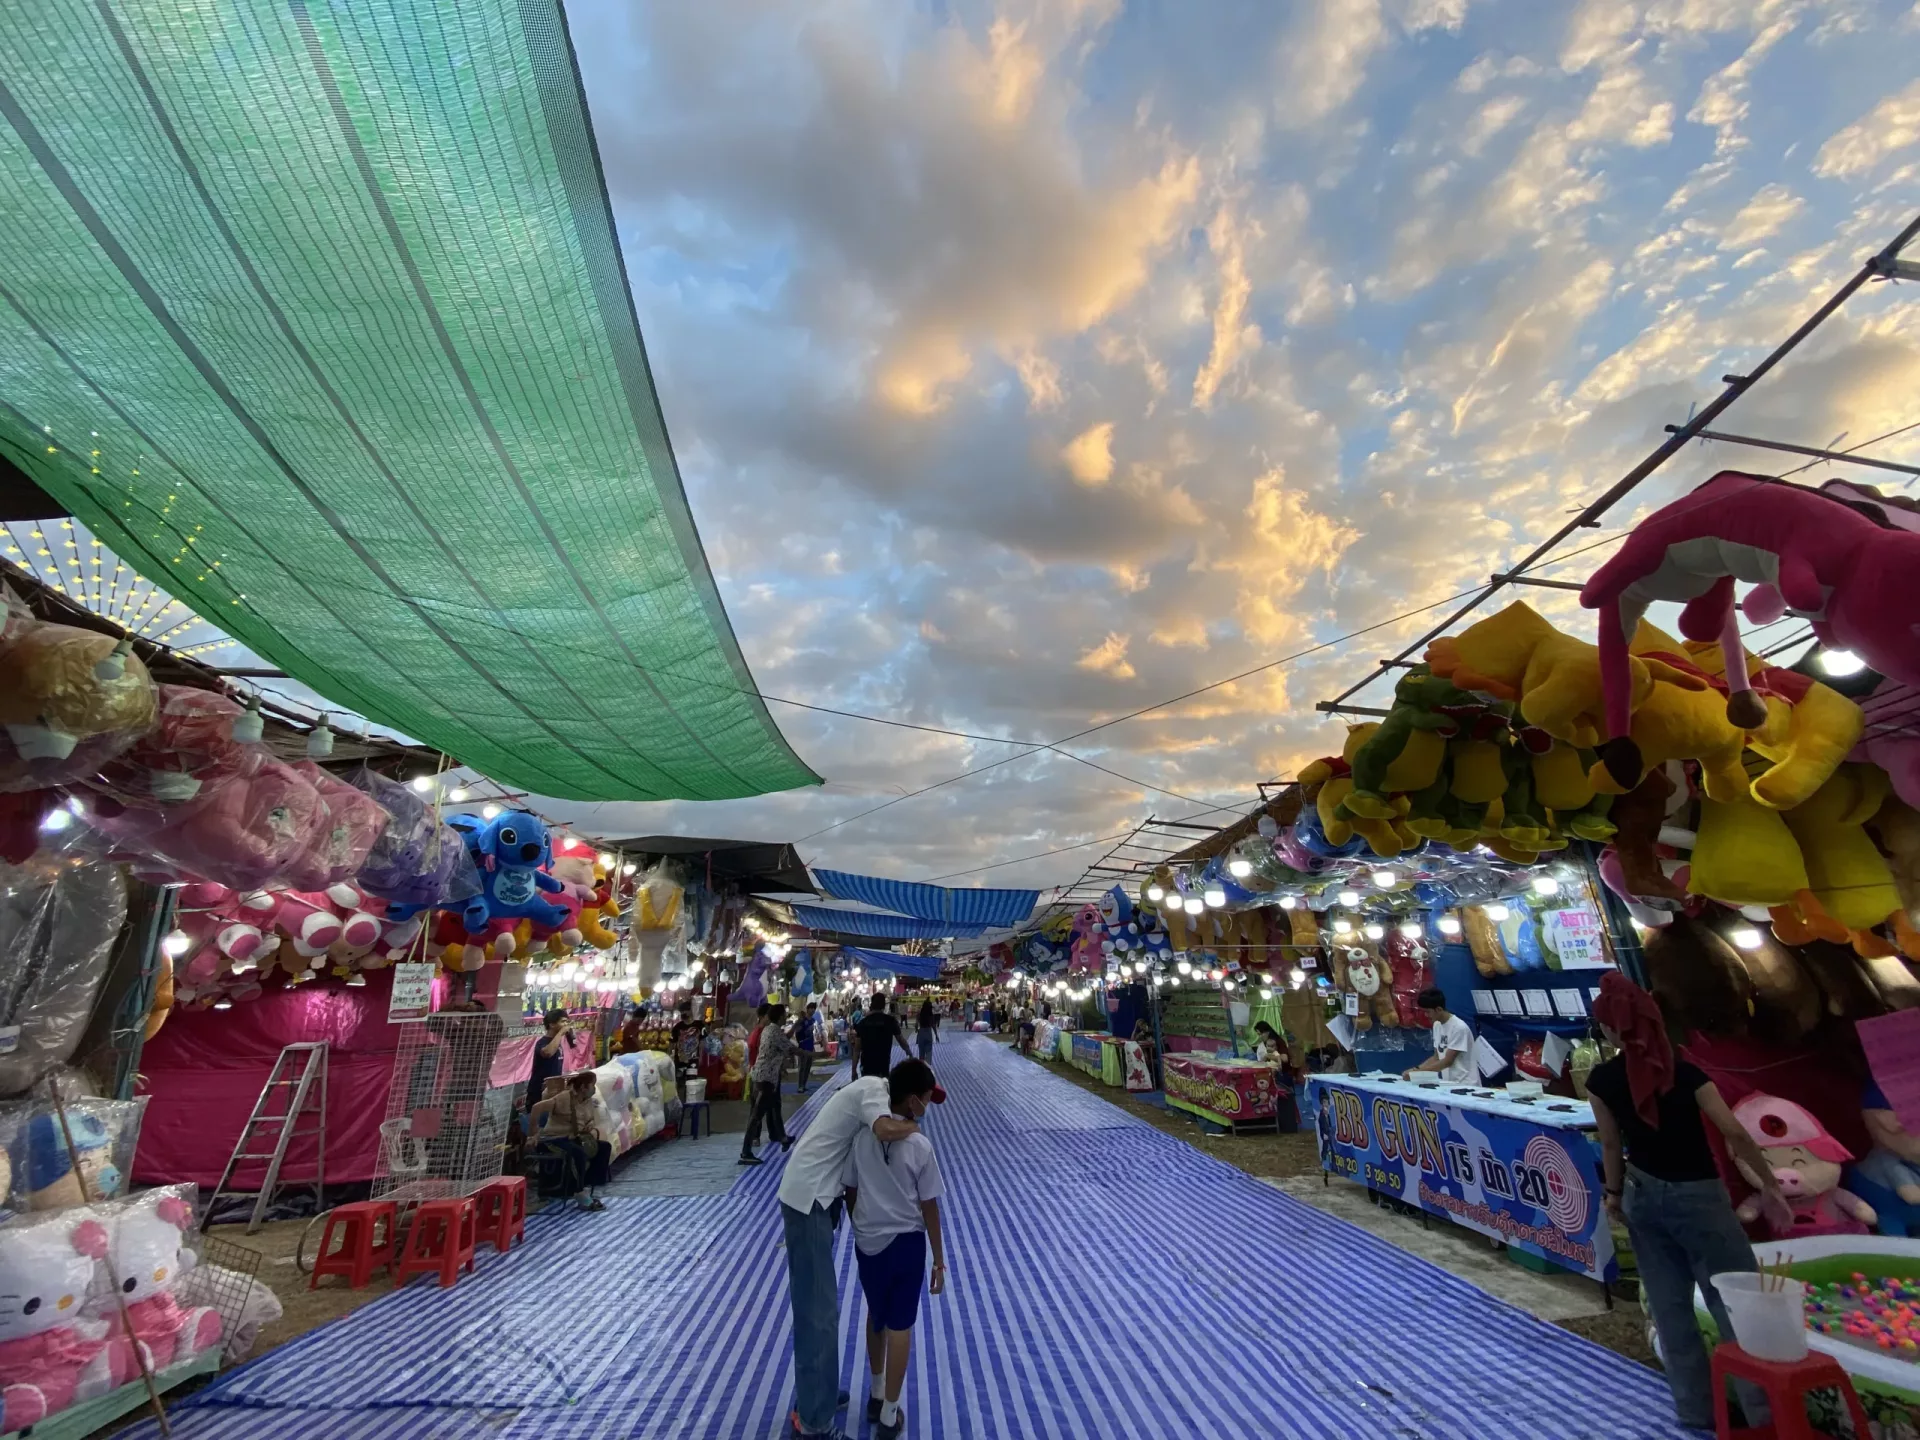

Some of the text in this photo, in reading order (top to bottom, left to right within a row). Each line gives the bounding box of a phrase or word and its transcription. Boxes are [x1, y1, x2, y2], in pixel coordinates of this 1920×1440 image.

[1564, 951, 1569, 960] 3
[1577, 949, 1588, 958] 50
[1330, 1089, 1447, 1179] BB GUN
[1346, 1157, 1358, 1173] 20
[1365, 1163, 1371, 1178] 3
[1388, 1172, 1401, 1190] 50
[1446, 1142, 1475, 1185] 15
[1512, 1160, 1552, 1211] 20
